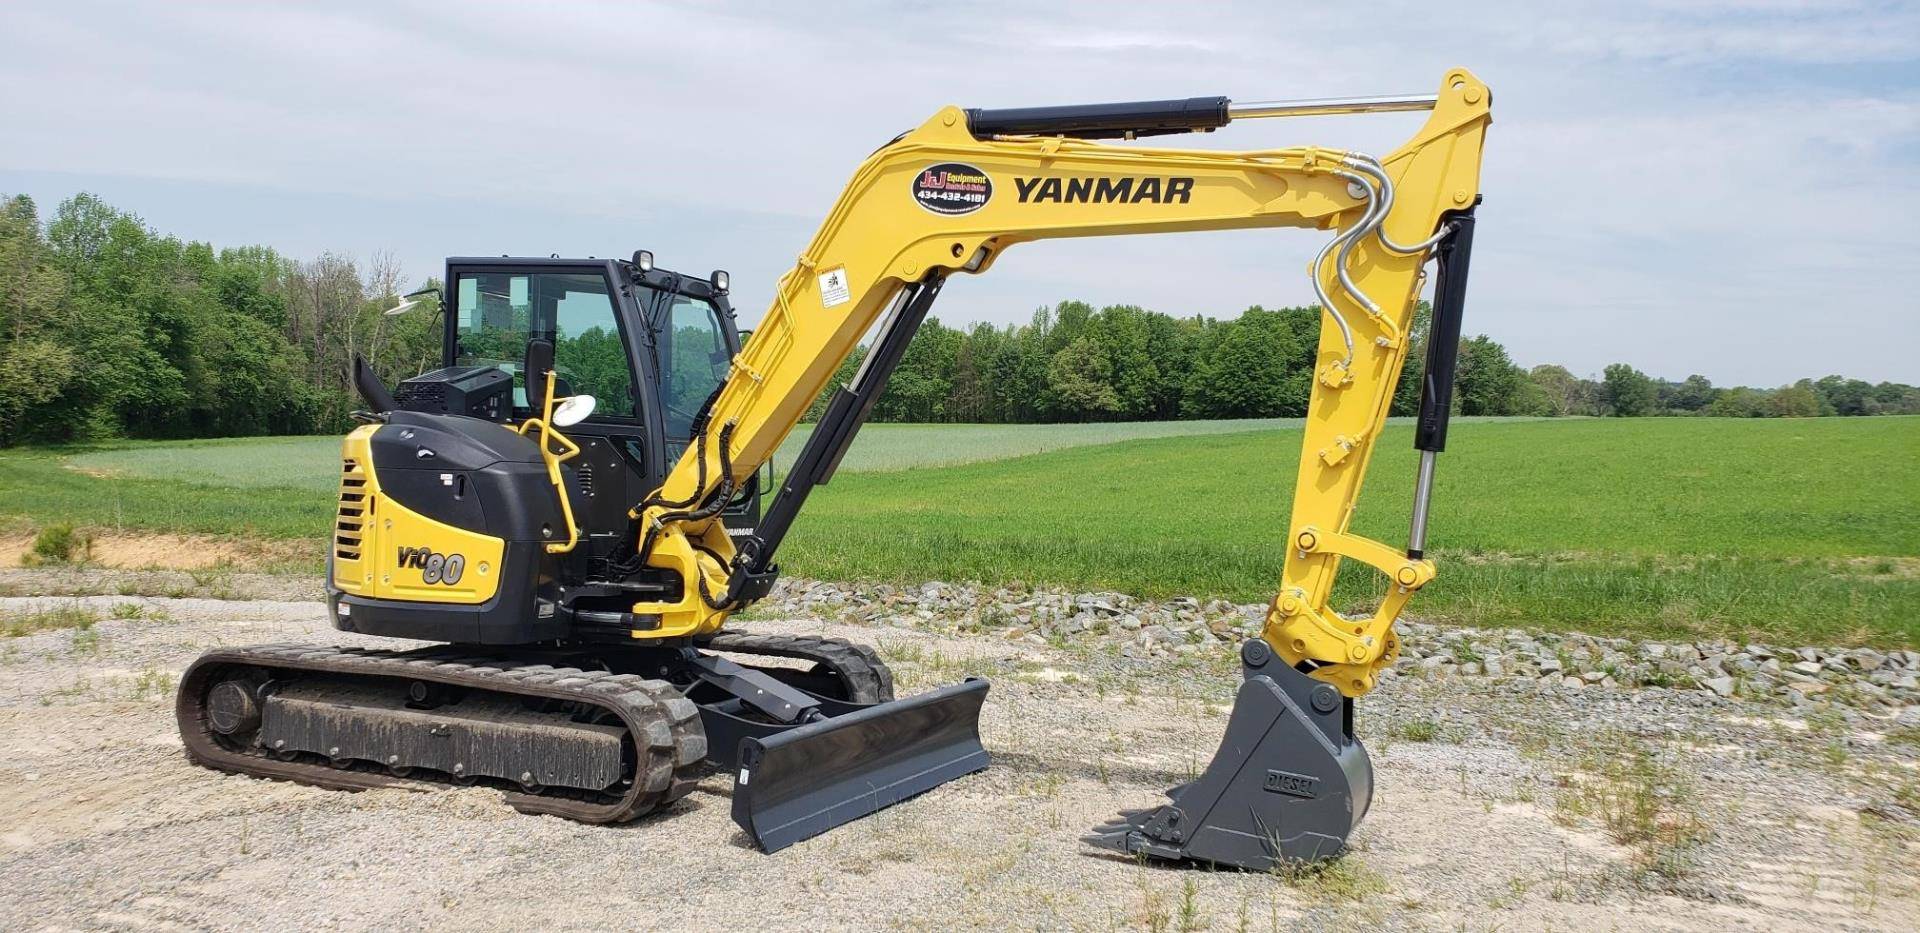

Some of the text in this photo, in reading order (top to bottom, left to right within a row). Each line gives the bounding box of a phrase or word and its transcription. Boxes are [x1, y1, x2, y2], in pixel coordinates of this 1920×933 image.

[947, 173, 986, 185] Equipment
[918, 190, 985, 203] 434-432-4181
[1014, 178, 1194, 204] YANMAR
[1266, 773, 1317, 795] DIESEL
